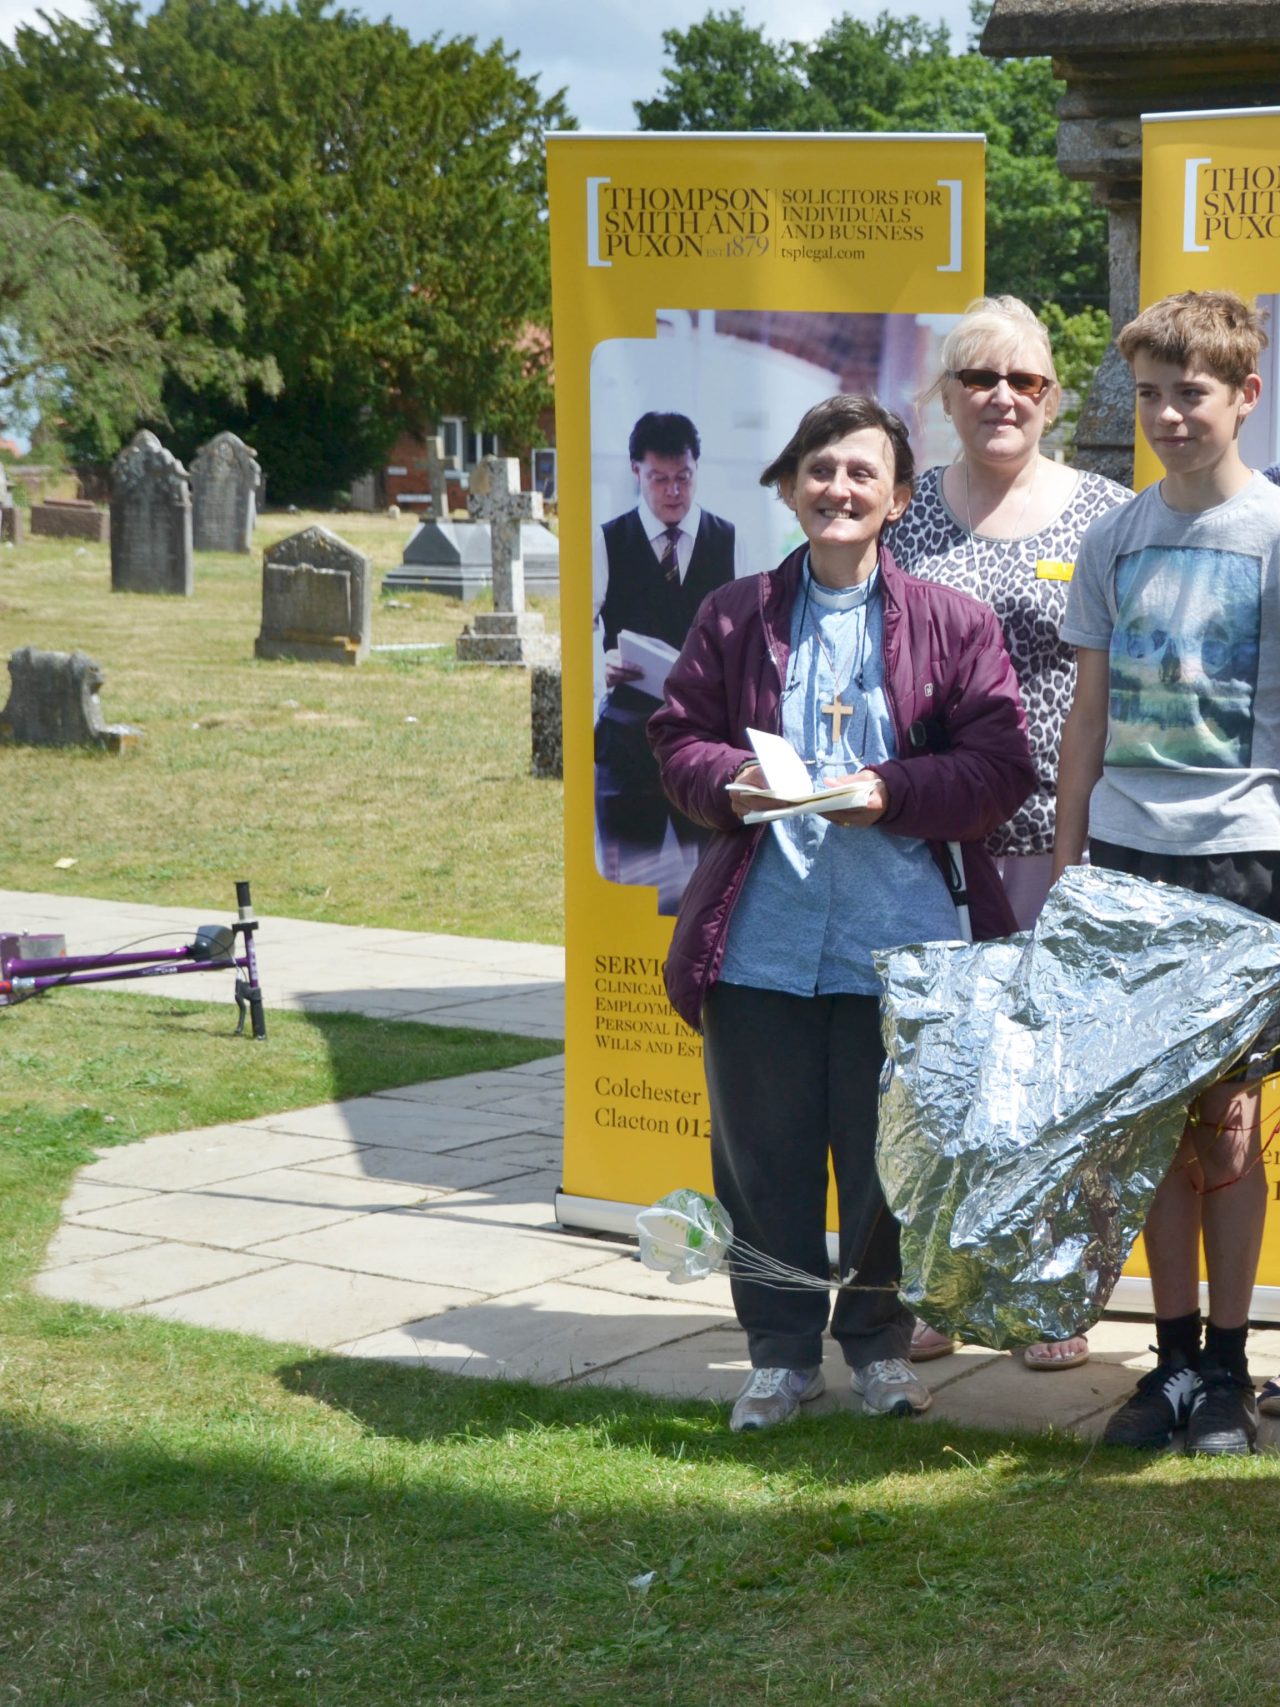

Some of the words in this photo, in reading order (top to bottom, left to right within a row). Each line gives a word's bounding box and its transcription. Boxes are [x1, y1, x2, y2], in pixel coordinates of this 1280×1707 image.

[604, 187, 770, 211] THOMPSON
[782, 188, 899, 205] SOLICITORS
[904, 190, 942, 206] FOR
[605, 211, 699, 234] SMITH
[706, 211, 770, 234] AND
[782, 206, 911, 223] INDIVIDUALS
[781, 224, 825, 240] AND
[830, 224, 924, 241] BUSINESS
[607, 234, 703, 257] PUXON
[725, 235, 770, 257] 1879
[781, 245, 865, 262] tsplegal.com
[595, 978, 666, 996] CLINICAL
[595, 1015, 670, 1035] PERSONAL
[595, 1034, 642, 1051] WILLS
[646, 1041, 673, 1055] AND
[595, 1076, 702, 1105] Colchester
[595, 1107, 669, 1134] Clacton
